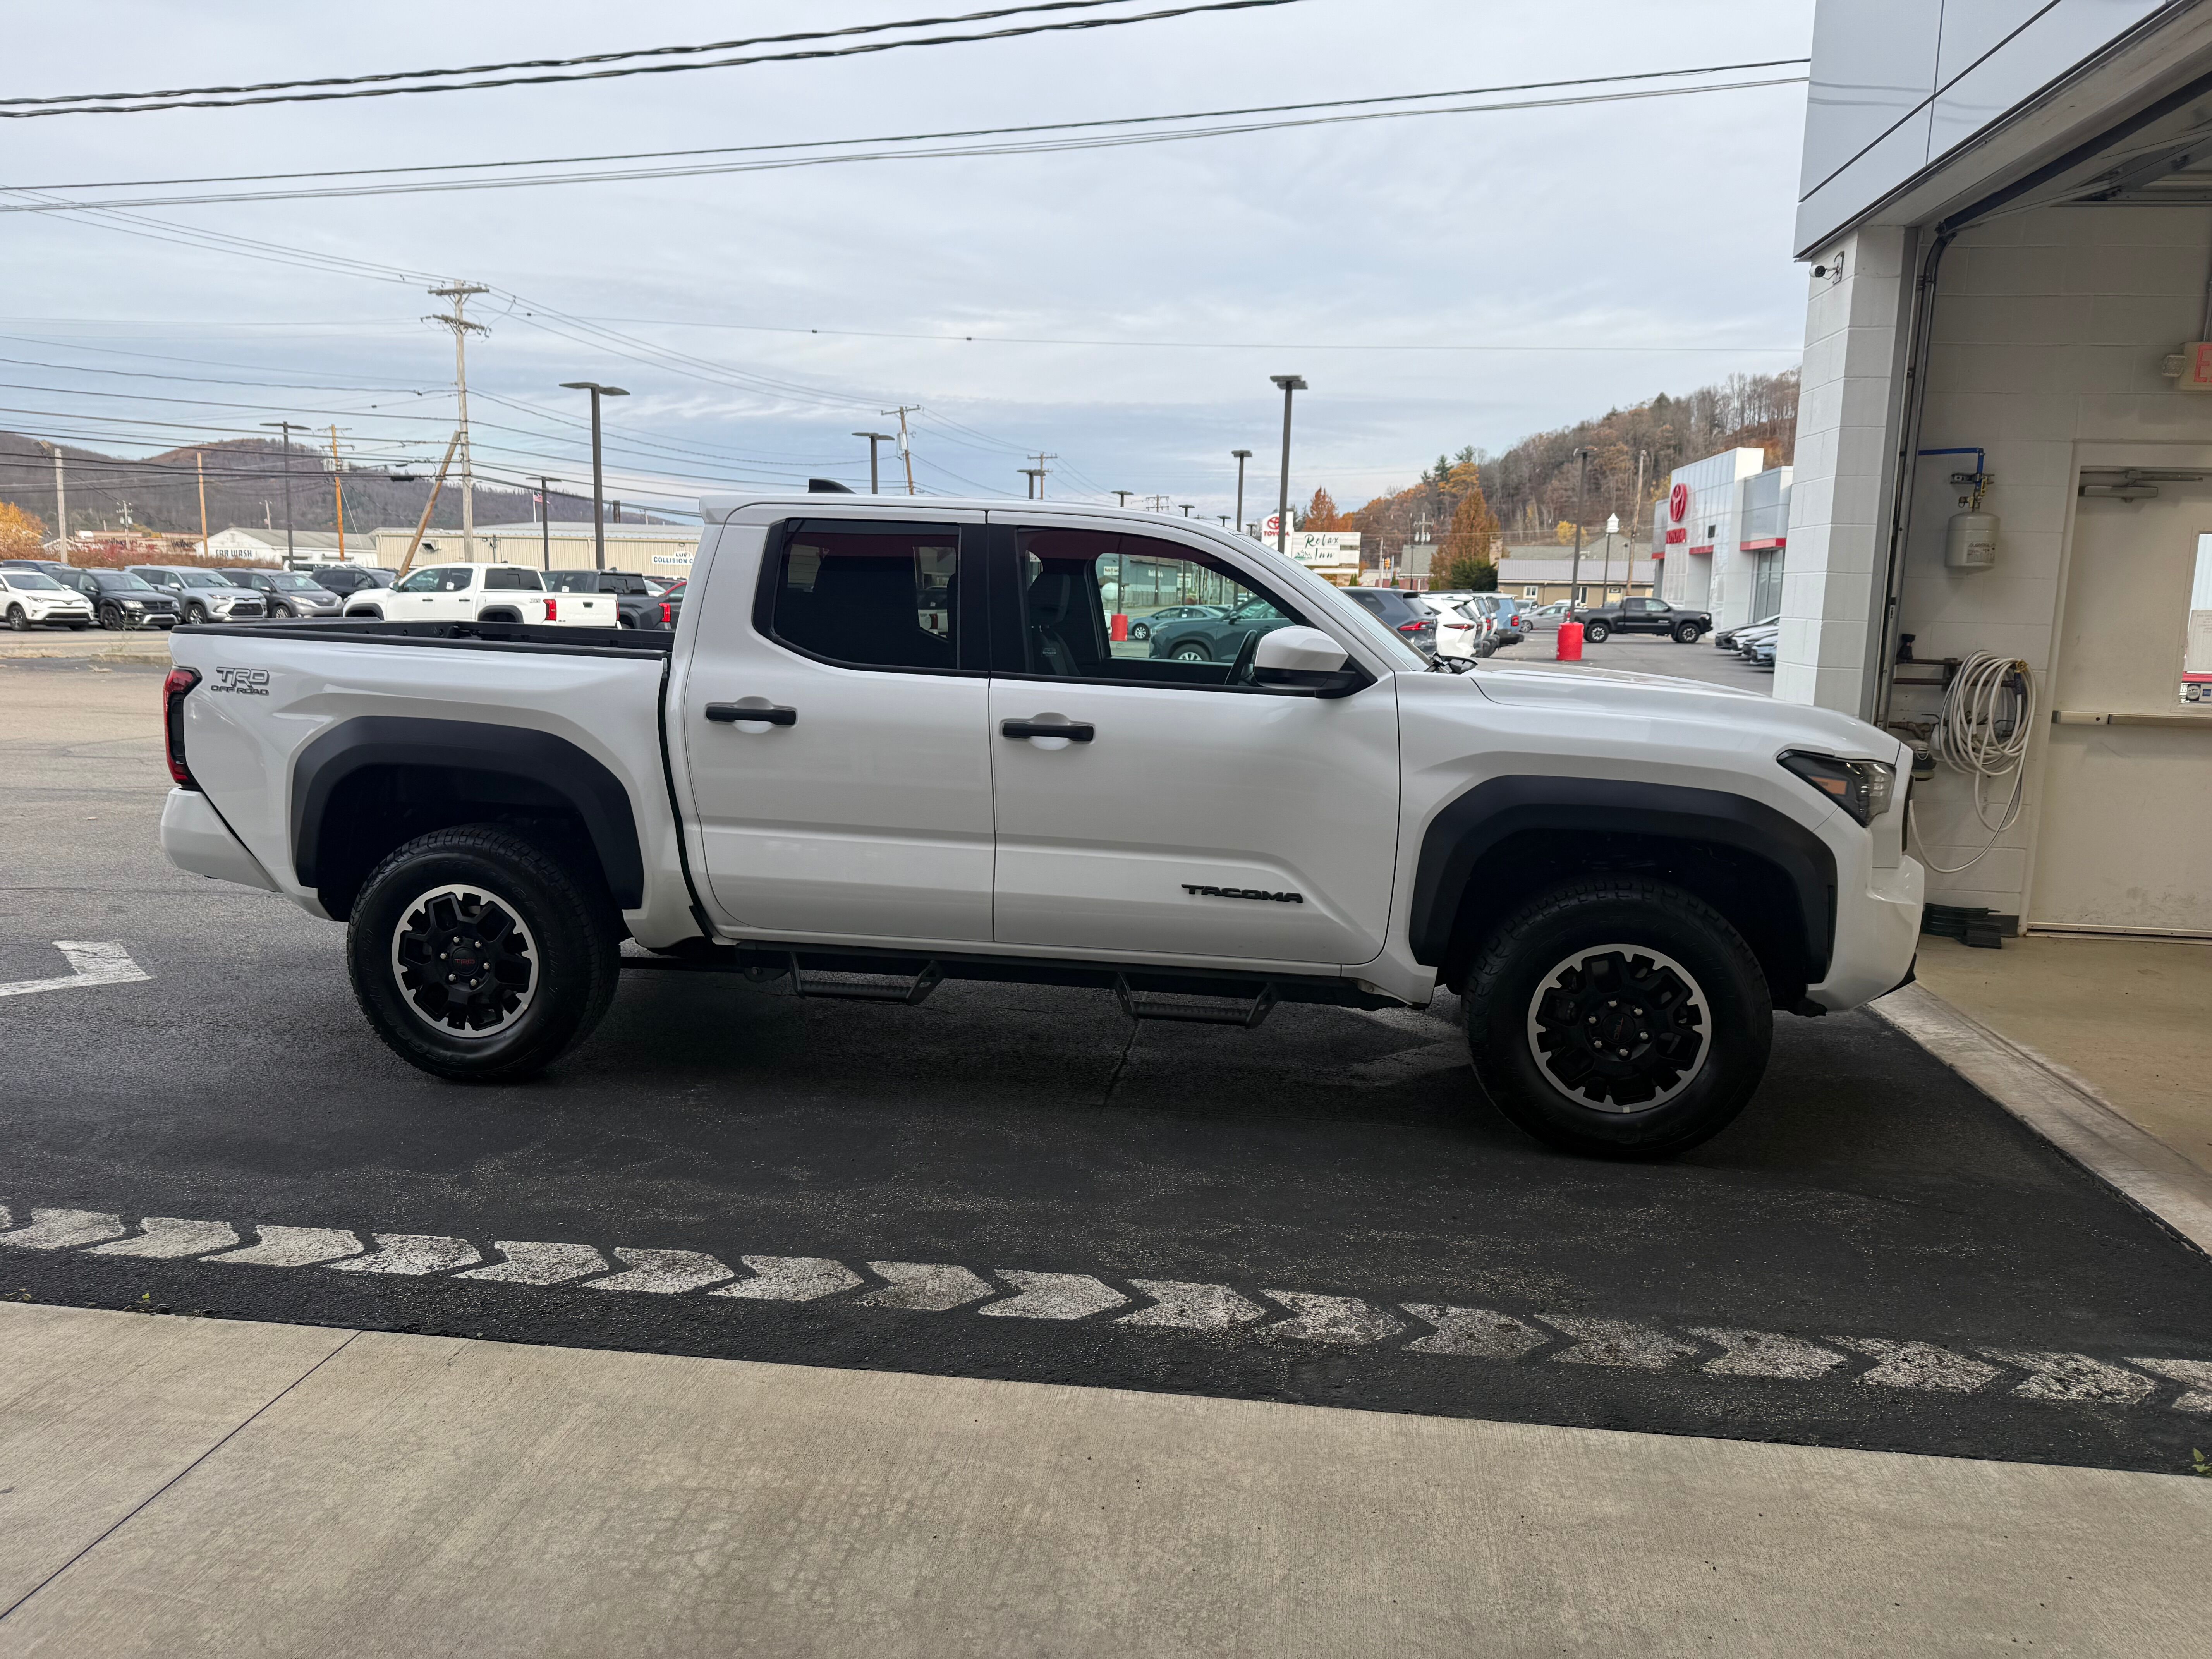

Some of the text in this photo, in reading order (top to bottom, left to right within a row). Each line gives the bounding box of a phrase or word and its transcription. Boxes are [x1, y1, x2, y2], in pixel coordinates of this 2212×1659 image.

[2193, 344, 2212, 383] E
[1305, 534, 1340, 549] Relax
[231, 549, 252, 557] WASH
[1315, 548, 1334, 560] Inn
[216, 666, 270, 688] TRD
[211, 685, 270, 696] OFF ROAD
[1181, 884, 1303, 903] TACOMA
